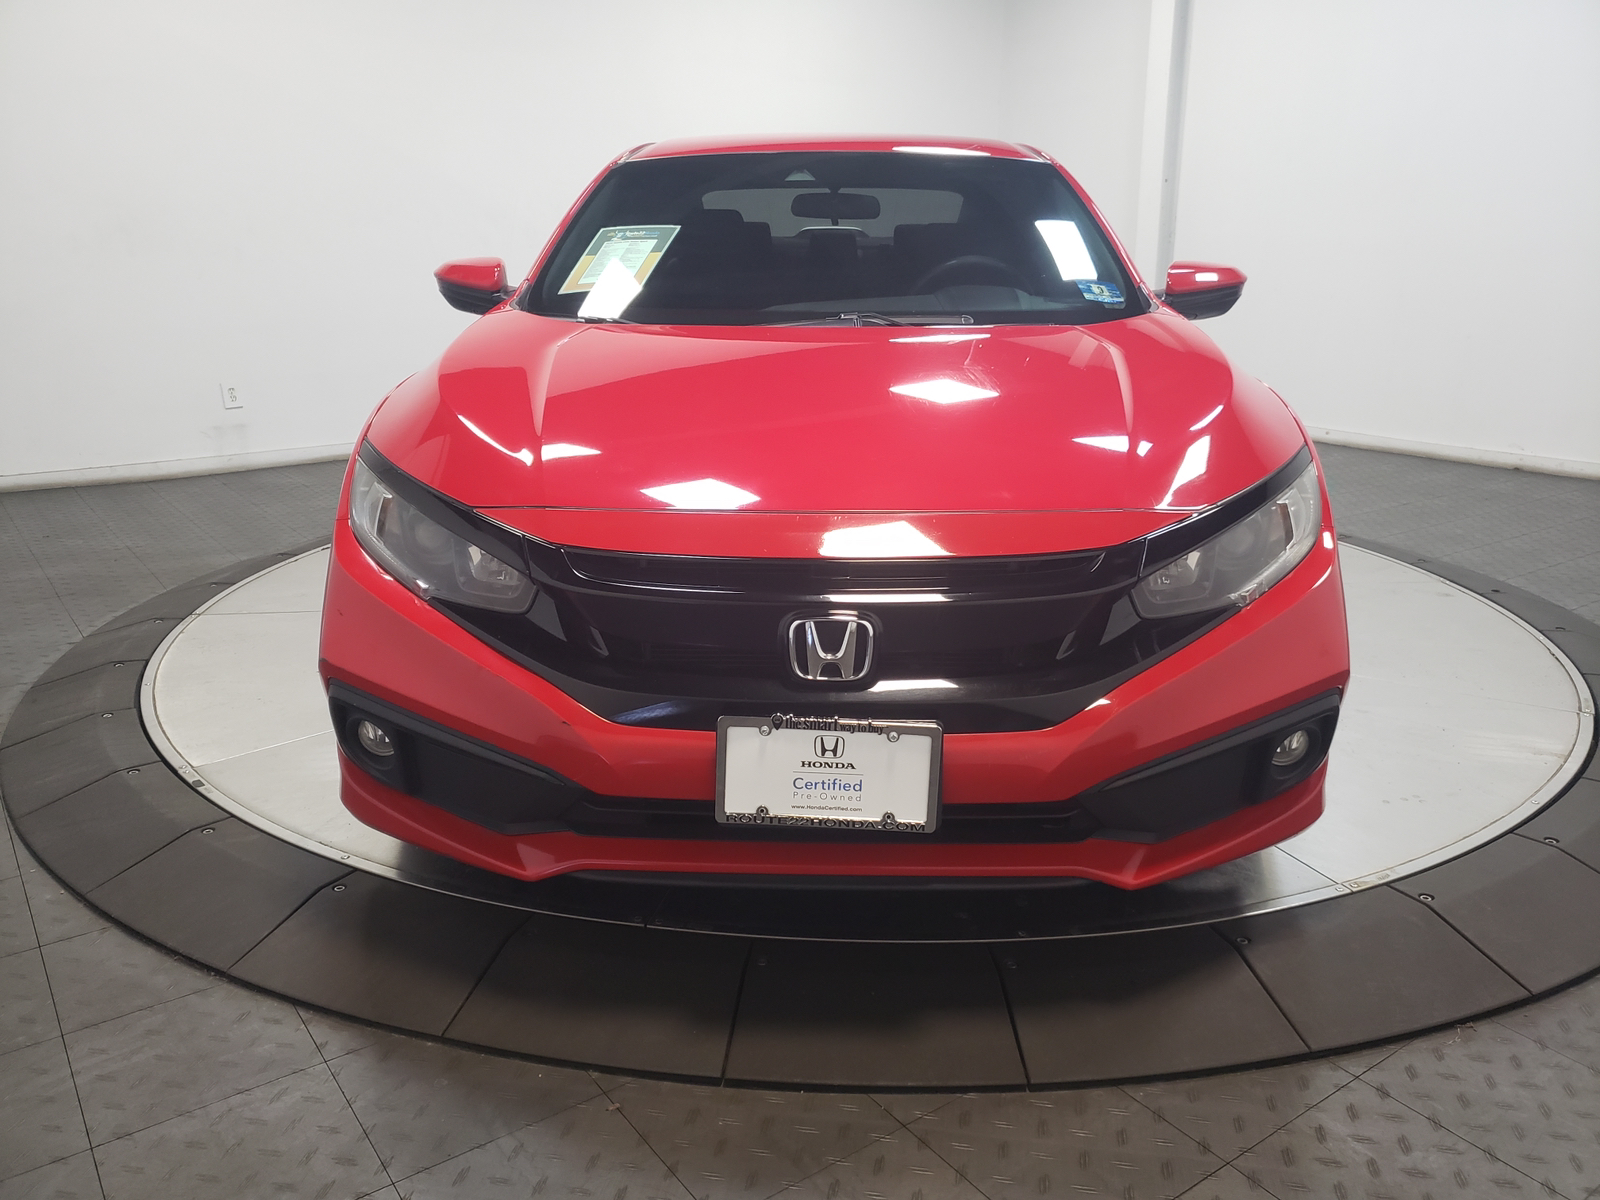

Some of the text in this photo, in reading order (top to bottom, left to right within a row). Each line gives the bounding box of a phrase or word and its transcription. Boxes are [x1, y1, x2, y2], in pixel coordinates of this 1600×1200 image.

[840, 723, 857, 734] way
[857, 722, 867, 732] to
[868, 719, 884, 735] buy
[800, 760, 857, 770] HONDA
[792, 777, 863, 792] Certified
[792, 791, 862, 802] Pre-Owned
[791, 804, 863, 812] www.HondaCertified.com
[725, 813, 926, 832] ROUTE22HONDA.COM
